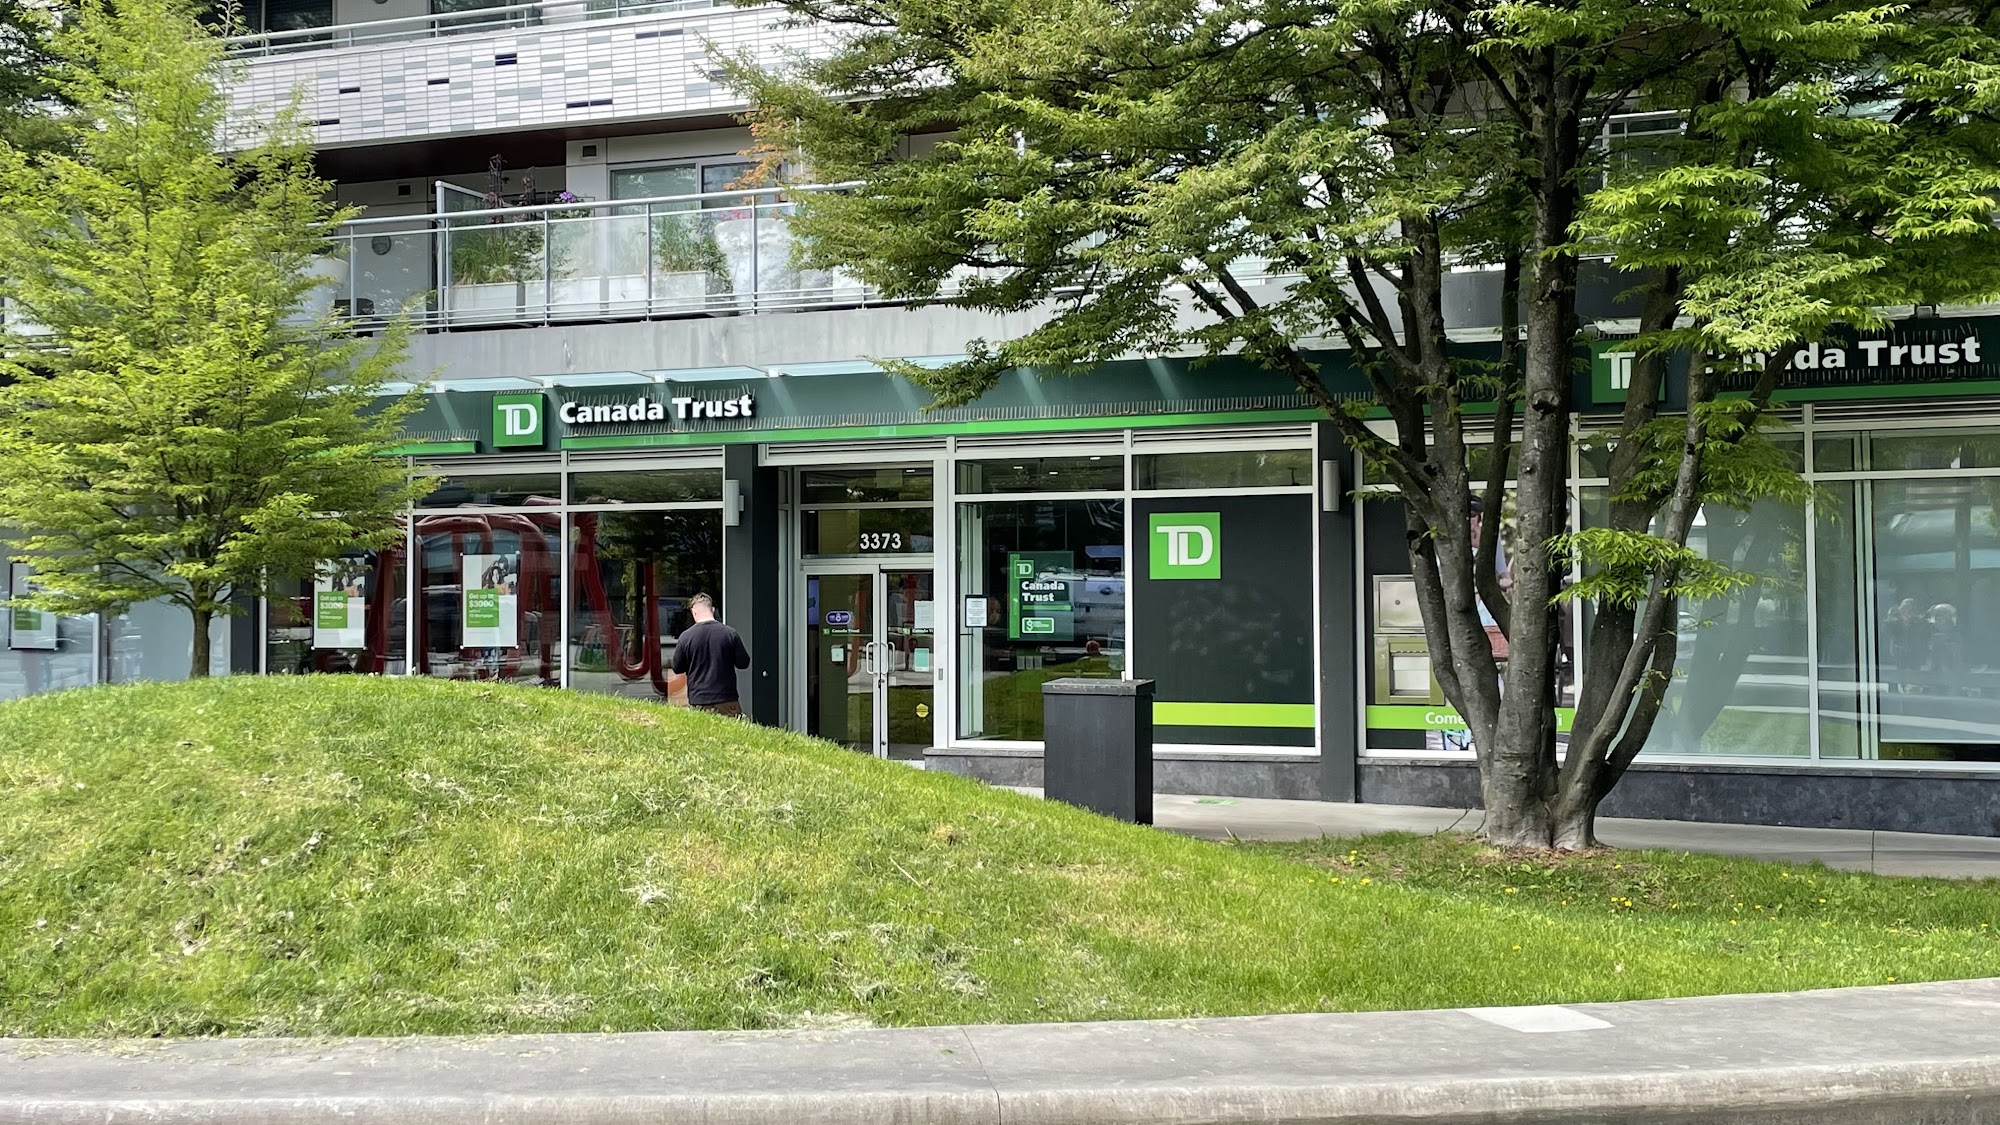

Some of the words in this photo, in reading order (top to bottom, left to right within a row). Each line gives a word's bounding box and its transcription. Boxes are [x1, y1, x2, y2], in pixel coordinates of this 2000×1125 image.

[1704, 341, 1846, 374] nda
[1857, 336, 1981, 367] Trust
[497, 403, 538, 436] TD
[559, 397, 664, 424] Canada
[671, 393, 752, 419] Trust
[860, 532, 902, 550] 3373
[1156, 525, 1214, 566] TD
[1016, 563, 1032, 575] TD
[1021, 580, 1065, 591] Canada
[468, 600, 494, 608] $3000
[1021, 592, 1055, 602] Trust
[1425, 711, 1467, 725] Come
